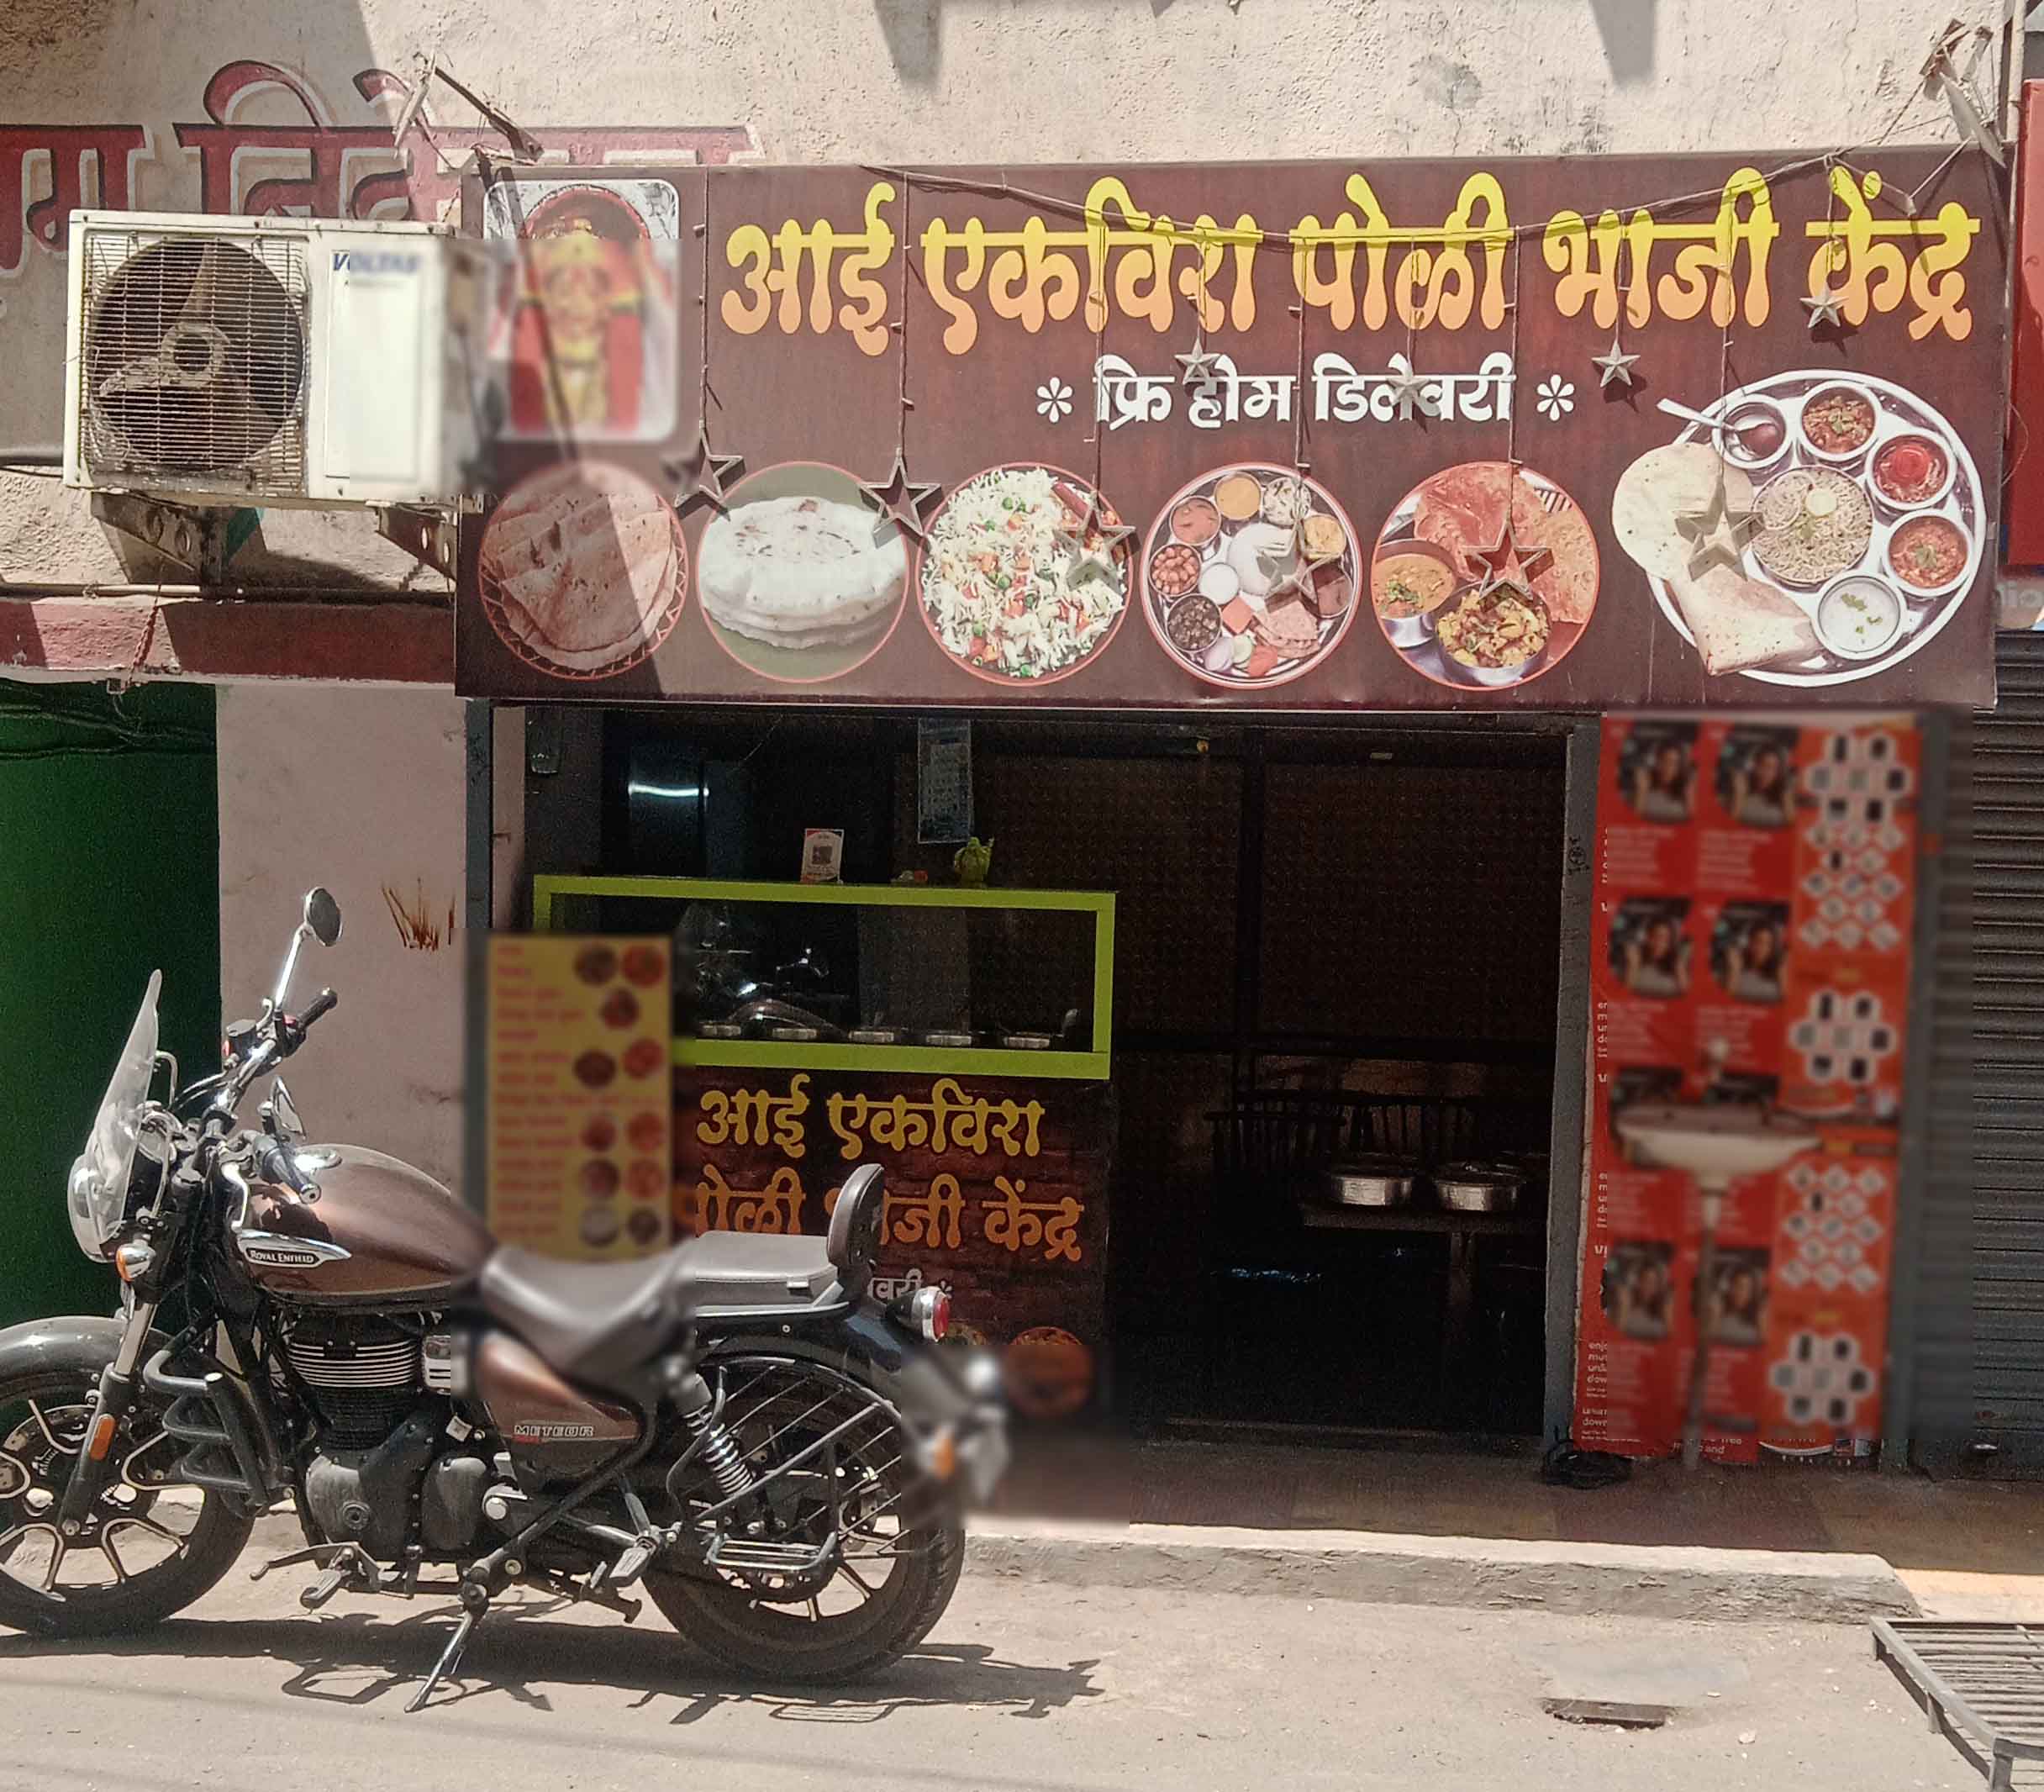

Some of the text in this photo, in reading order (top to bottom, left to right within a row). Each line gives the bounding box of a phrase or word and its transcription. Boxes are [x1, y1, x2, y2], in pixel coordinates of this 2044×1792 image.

[720, 166, 1981, 356] आई एकविरा पोळी भाजी केंद्र
[1093, 354, 1176, 430] फ्रि
[1179, 355, 1297, 429] होम
[695, 1073, 1046, 1160] आई एकविरा
[250, 1249, 315, 1264] ROYAL ENFIELD
[823, 1173, 967, 1250] ाजी
[982, 1175, 1086, 1262] केंद्र
[514, 1425, 594, 1437] METEOR
